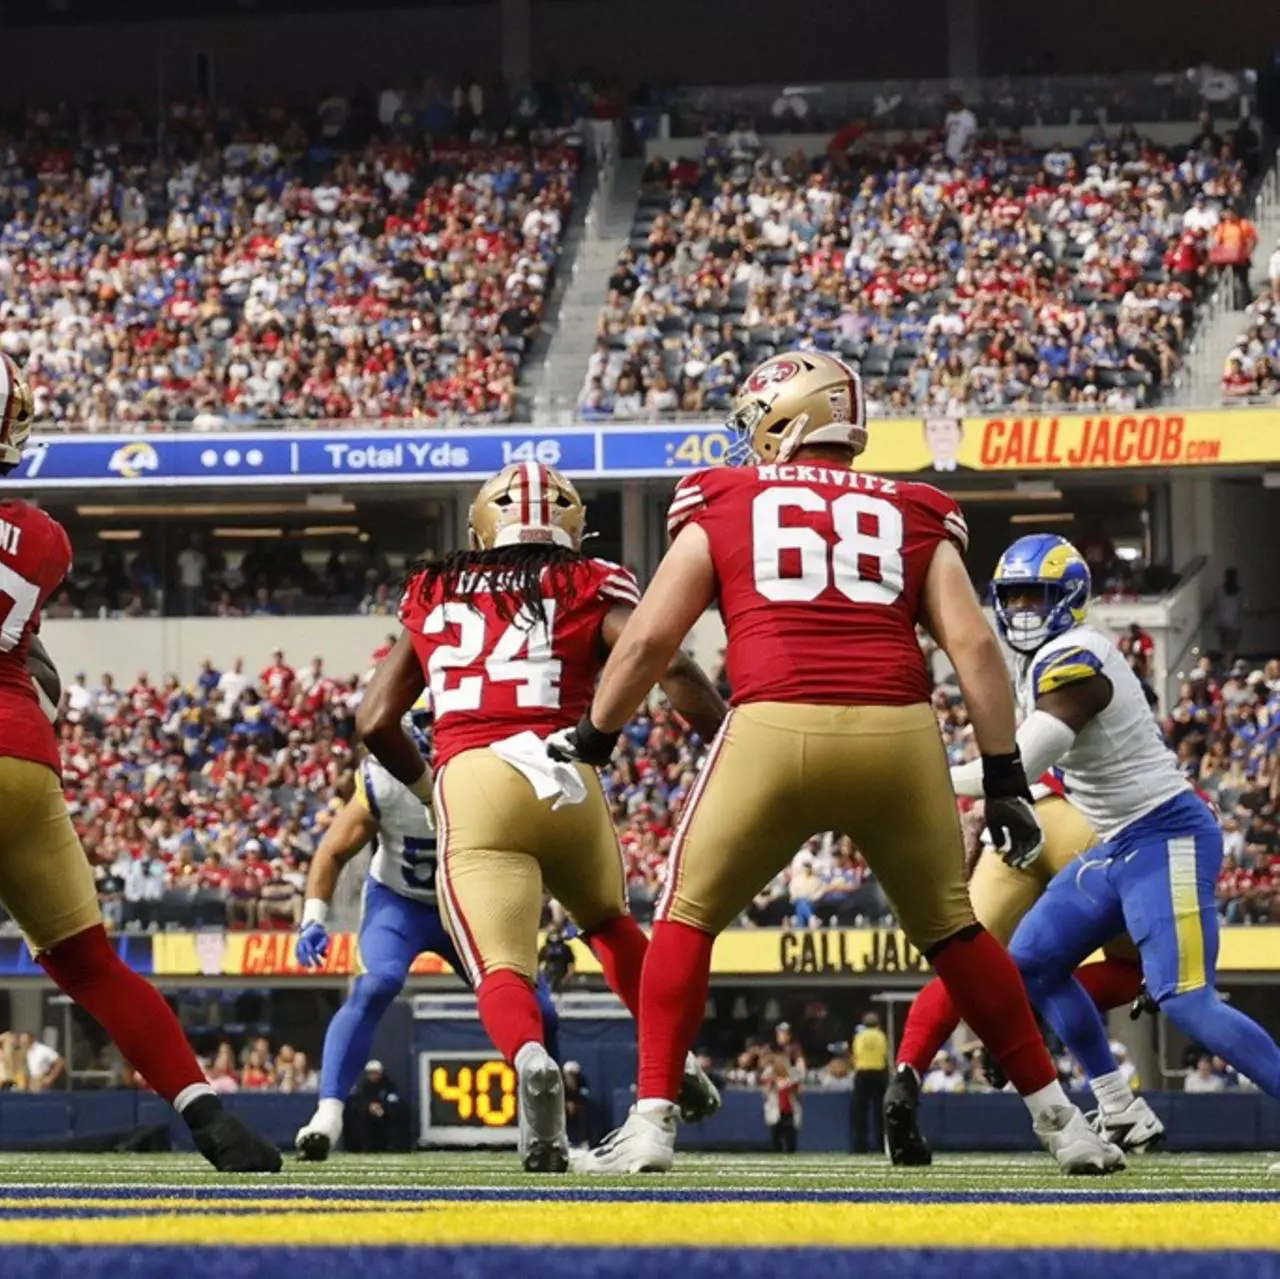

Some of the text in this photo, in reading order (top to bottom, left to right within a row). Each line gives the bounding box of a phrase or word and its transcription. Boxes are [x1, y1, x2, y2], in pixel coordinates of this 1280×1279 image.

[324, 440, 561, 468] Total Yds 146
[752, 486, 905, 605] 68
[422, 598, 562, 716] 24
[432, 1060, 516, 1126] 40
